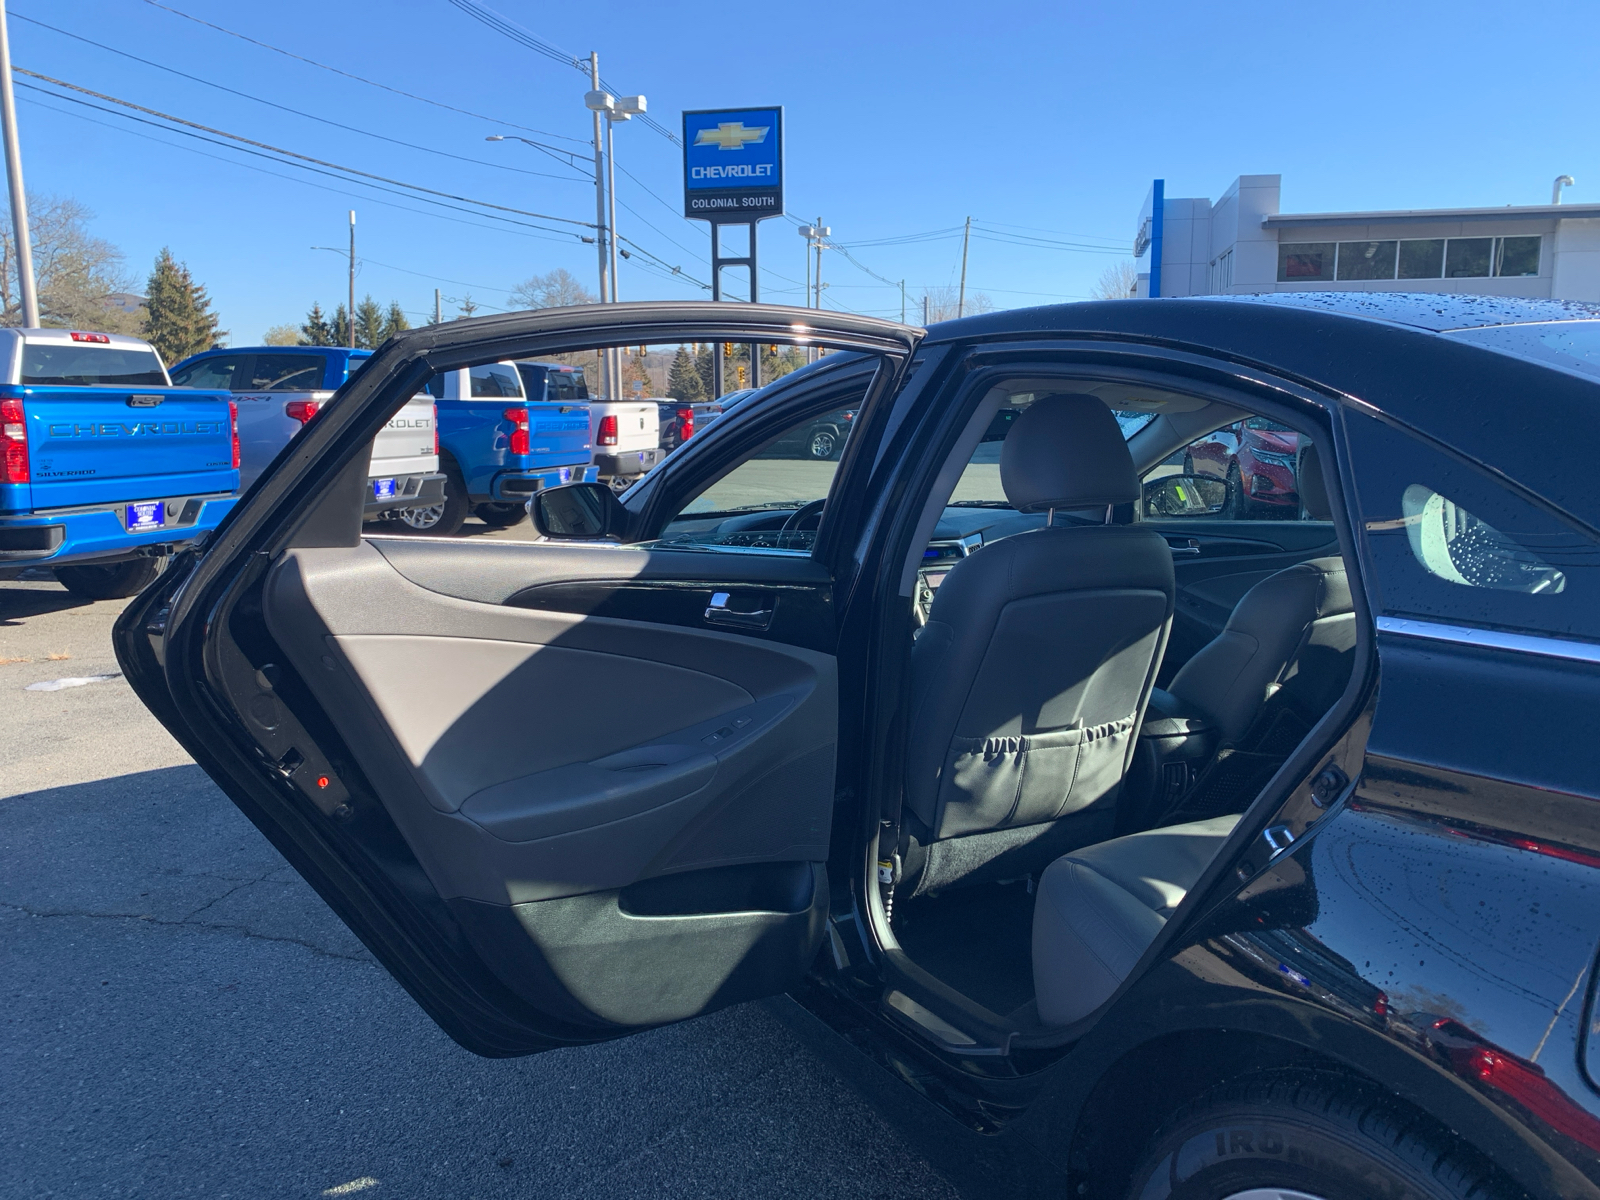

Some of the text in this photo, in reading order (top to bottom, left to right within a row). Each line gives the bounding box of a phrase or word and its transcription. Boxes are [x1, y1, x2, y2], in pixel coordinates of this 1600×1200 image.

[691, 164, 773, 179] CHEVROLET
[691, 197, 775, 208] COLONIAL SOUTH
[50, 421, 225, 438] CHEVROLET
[36, 469, 96, 478] SILVERADO
